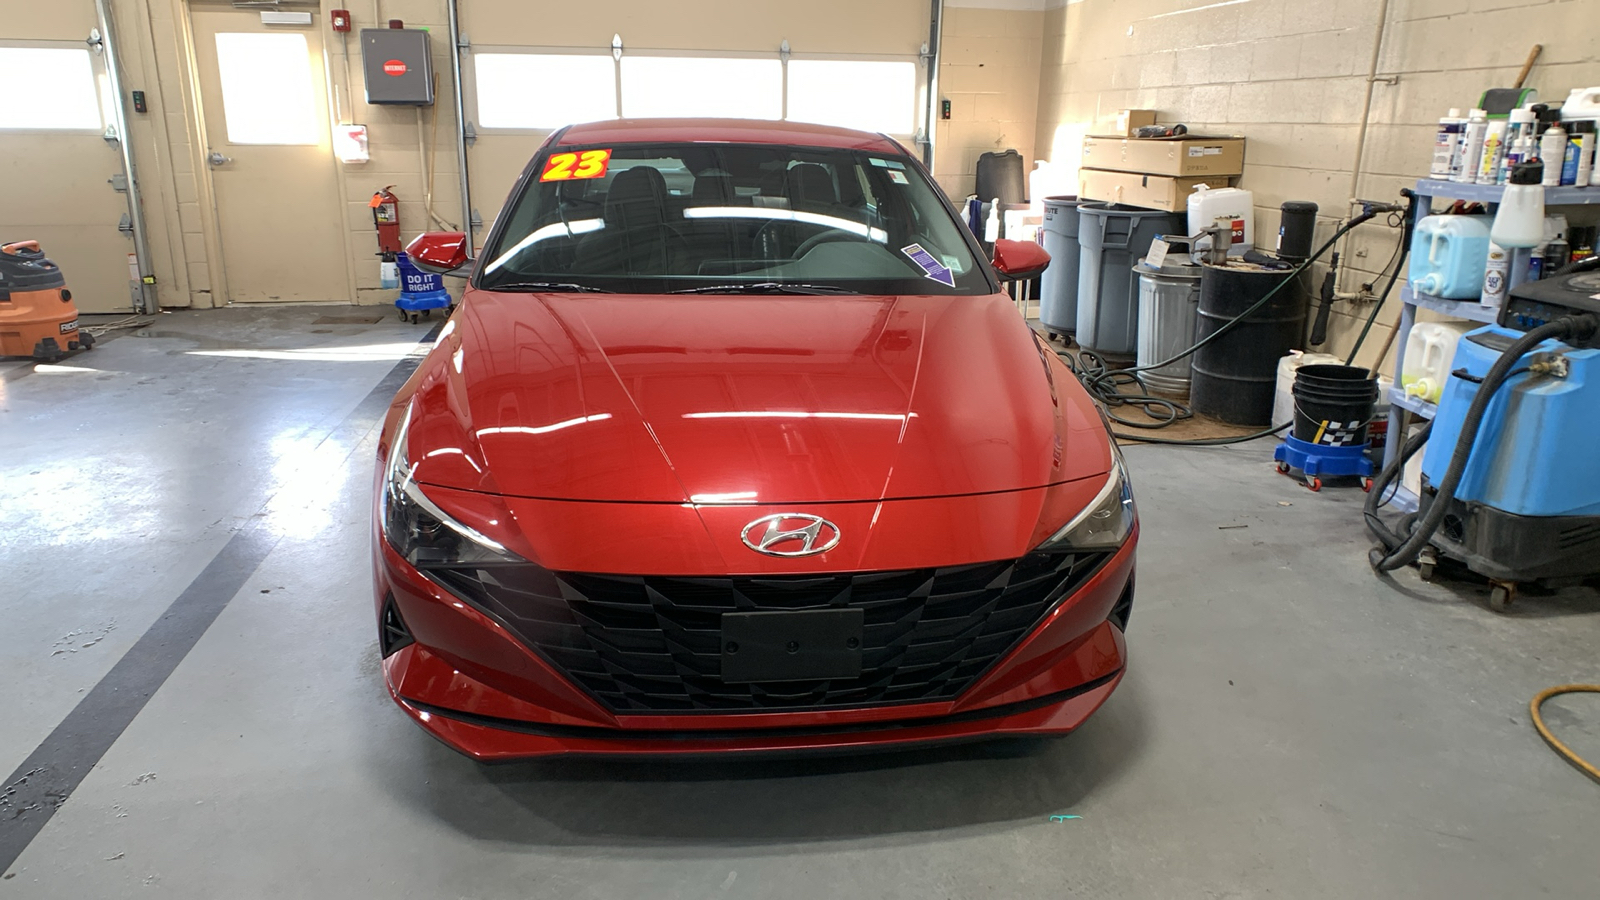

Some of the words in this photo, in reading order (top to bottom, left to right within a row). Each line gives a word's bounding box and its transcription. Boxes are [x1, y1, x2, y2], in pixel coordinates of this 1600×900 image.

[542, 150, 608, 180] 23
[407, 275, 421, 283] DO
[424, 274, 433, 283] IT
[409, 283, 434, 291] RIGHT
